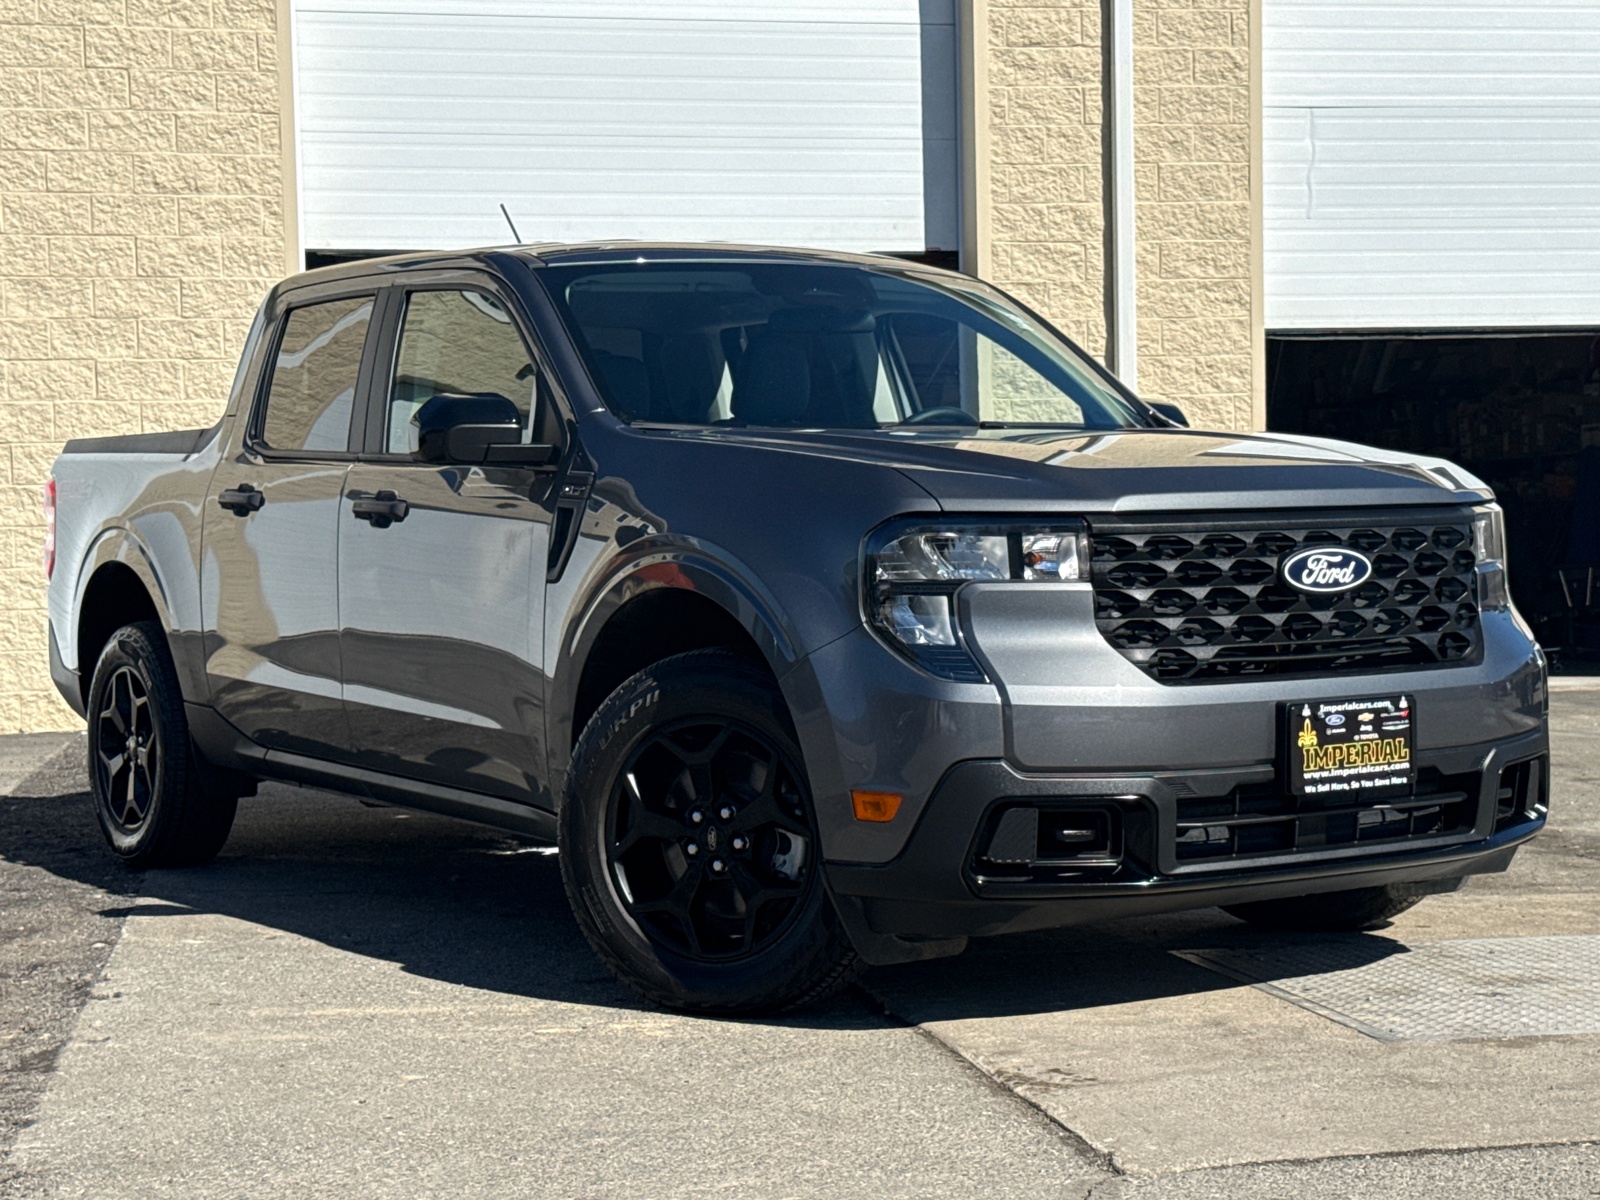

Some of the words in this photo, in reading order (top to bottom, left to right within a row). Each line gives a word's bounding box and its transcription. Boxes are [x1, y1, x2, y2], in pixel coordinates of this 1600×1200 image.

[1302, 554, 1356, 584] Ford
[1303, 738, 1410, 771] IMPERIAL
[1304, 785, 1316, 794] We
[1317, 783, 1330, 792] Sell
[1331, 782, 1350, 791] More,
[1351, 781, 1360, 789] So
[1361, 779, 1374, 788] You
[1375, 778, 1390, 786] Save
